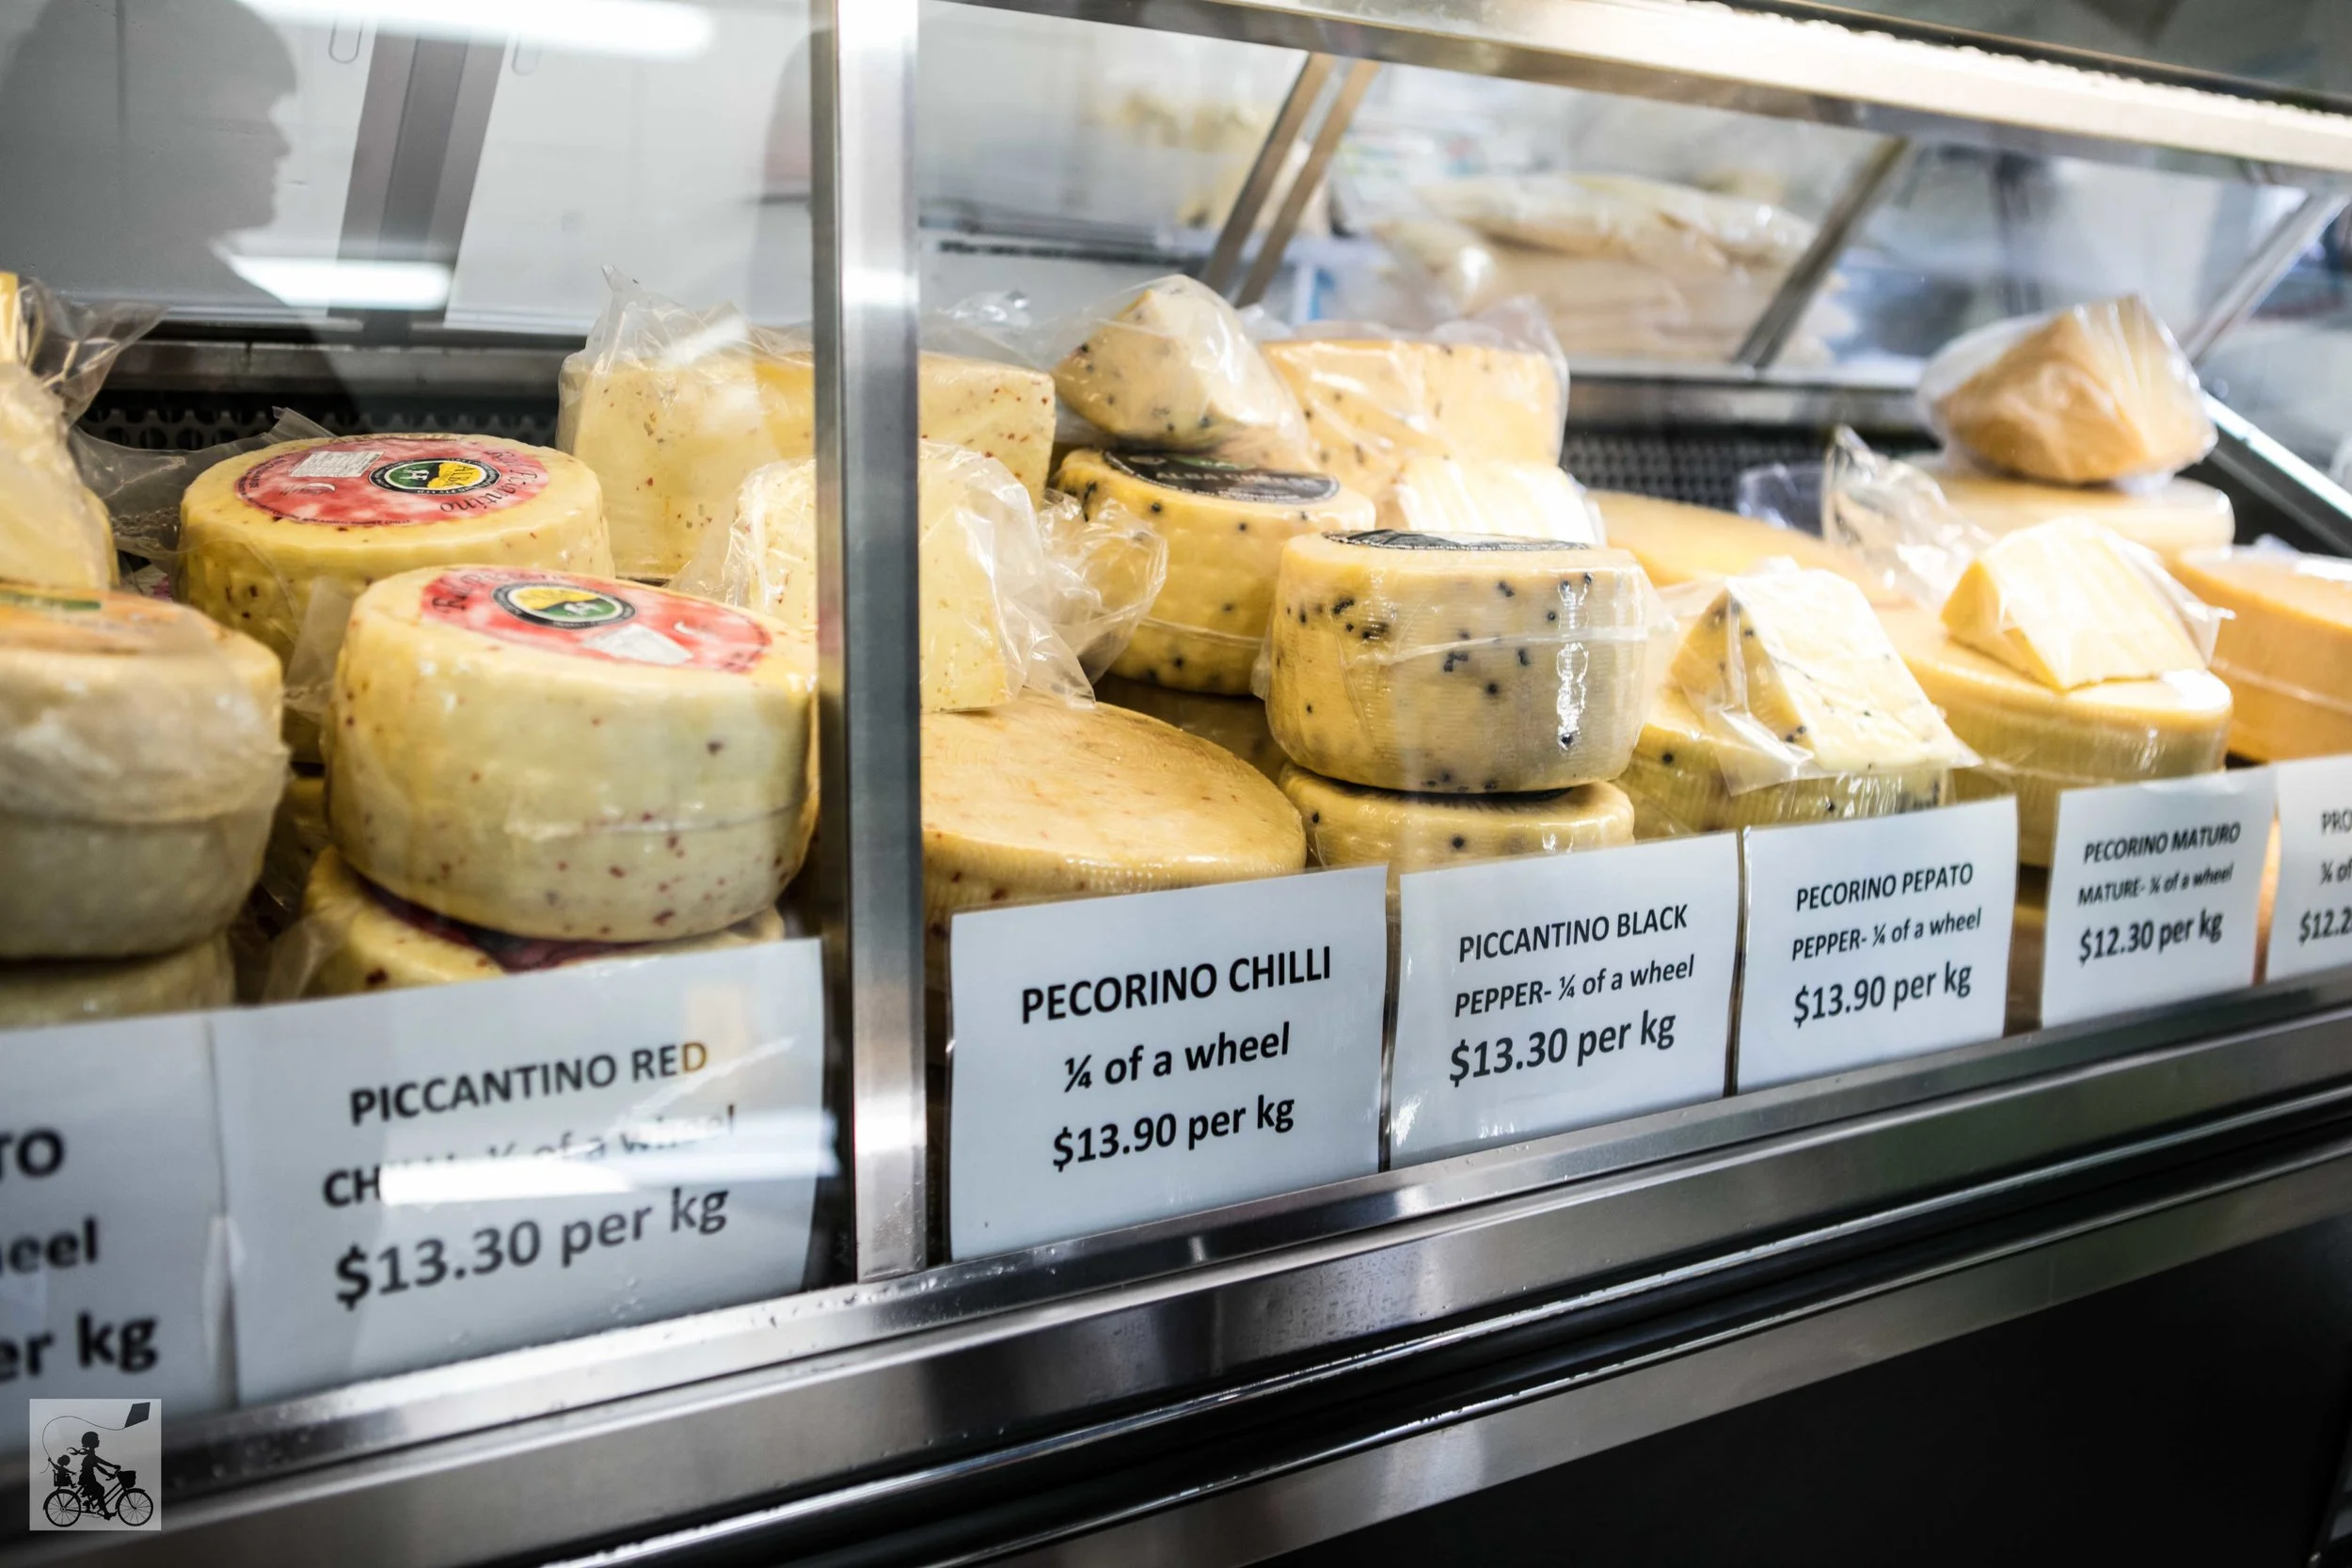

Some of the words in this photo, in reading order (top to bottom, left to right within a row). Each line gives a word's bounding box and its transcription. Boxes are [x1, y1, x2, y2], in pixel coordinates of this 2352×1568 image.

[2083, 832, 2169, 864] PECORINO
[2170, 821, 2241, 852] MATURO
[1796, 874, 1897, 912] PECORINO
[1901, 863, 1974, 895] PEPATO
[2164, 874, 2181, 892] of
[2180, 873, 2190, 889] a
[2192, 862, 2235, 887] wheel
[1459, 915, 1610, 963] PICCANTINO
[1616, 904, 1688, 939] BLACK
[1791, 928, 1867, 961] PEPPER-
[1891, 918, 1911, 942] of
[1914, 922, 1924, 939] a
[1930, 907, 1981, 937] wheel
[2078, 919, 2154, 967] $12.30
[2158, 916, 2195, 954] per
[2199, 907, 2223, 943] kg
[1022, 963, 1217, 1024] PECORINO
[1229, 945, 1330, 992] CHILLI
[1454, 980, 1551, 1018] PEPPER-
[1582, 968, 1607, 995] of
[1611, 972, 1623, 990] a
[1629, 953, 1694, 988] wheel
[1793, 975, 1886, 1029] $13.90
[1893, 972, 1936, 1012] per
[1944, 960, 1972, 999] kg
[1104, 1044, 1144, 1085] of
[1152, 1050, 1172, 1078] a
[1184, 1021, 1290, 1071] wheel
[1449, 1027, 1567, 1087] $13.30
[1577, 1021, 1631, 1067] per
[1640, 1009, 1676, 1050] kg
[350, 1054, 616, 1126] PICCANTINO
[631, 1041, 707, 1083] RED
[1052, 1113, 1176, 1172] $13.90
[1187, 1106, 1247, 1150] per
[1257, 1094, 1295, 1133] kg
[0, 1213, 99, 1277] eel
[336, 1220, 541, 1311] $13.30
[561, 1206, 652, 1269] per
[670, 1186, 729, 1234] kg
[75, 1307, 159, 1374] kg
